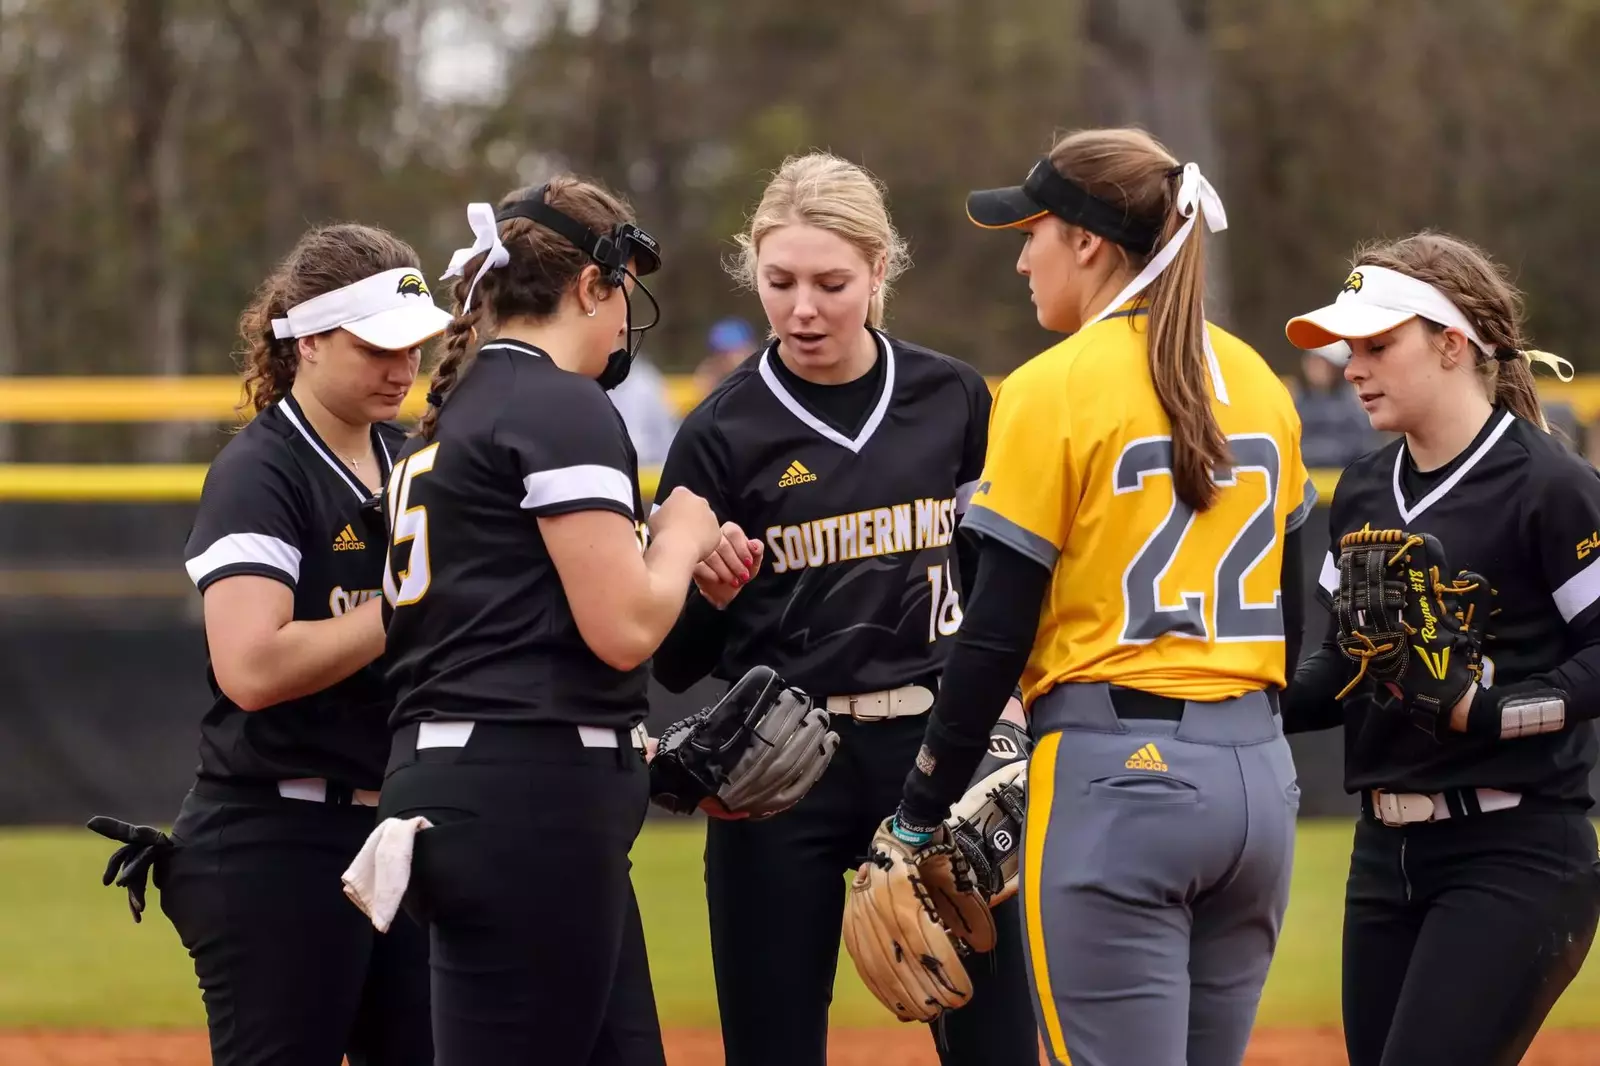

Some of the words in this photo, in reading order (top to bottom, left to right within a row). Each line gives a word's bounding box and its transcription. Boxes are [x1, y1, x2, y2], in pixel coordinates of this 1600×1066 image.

[778, 472, 818, 488] adidas
[332, 539, 366, 551] adidas
[766, 502, 912, 574] SOUTHERN
[1113, 433, 1286, 646] 22
[1408, 568, 1426, 593] #18
[927, 558, 964, 644] 16
[1124, 758, 1169, 773] adidas
